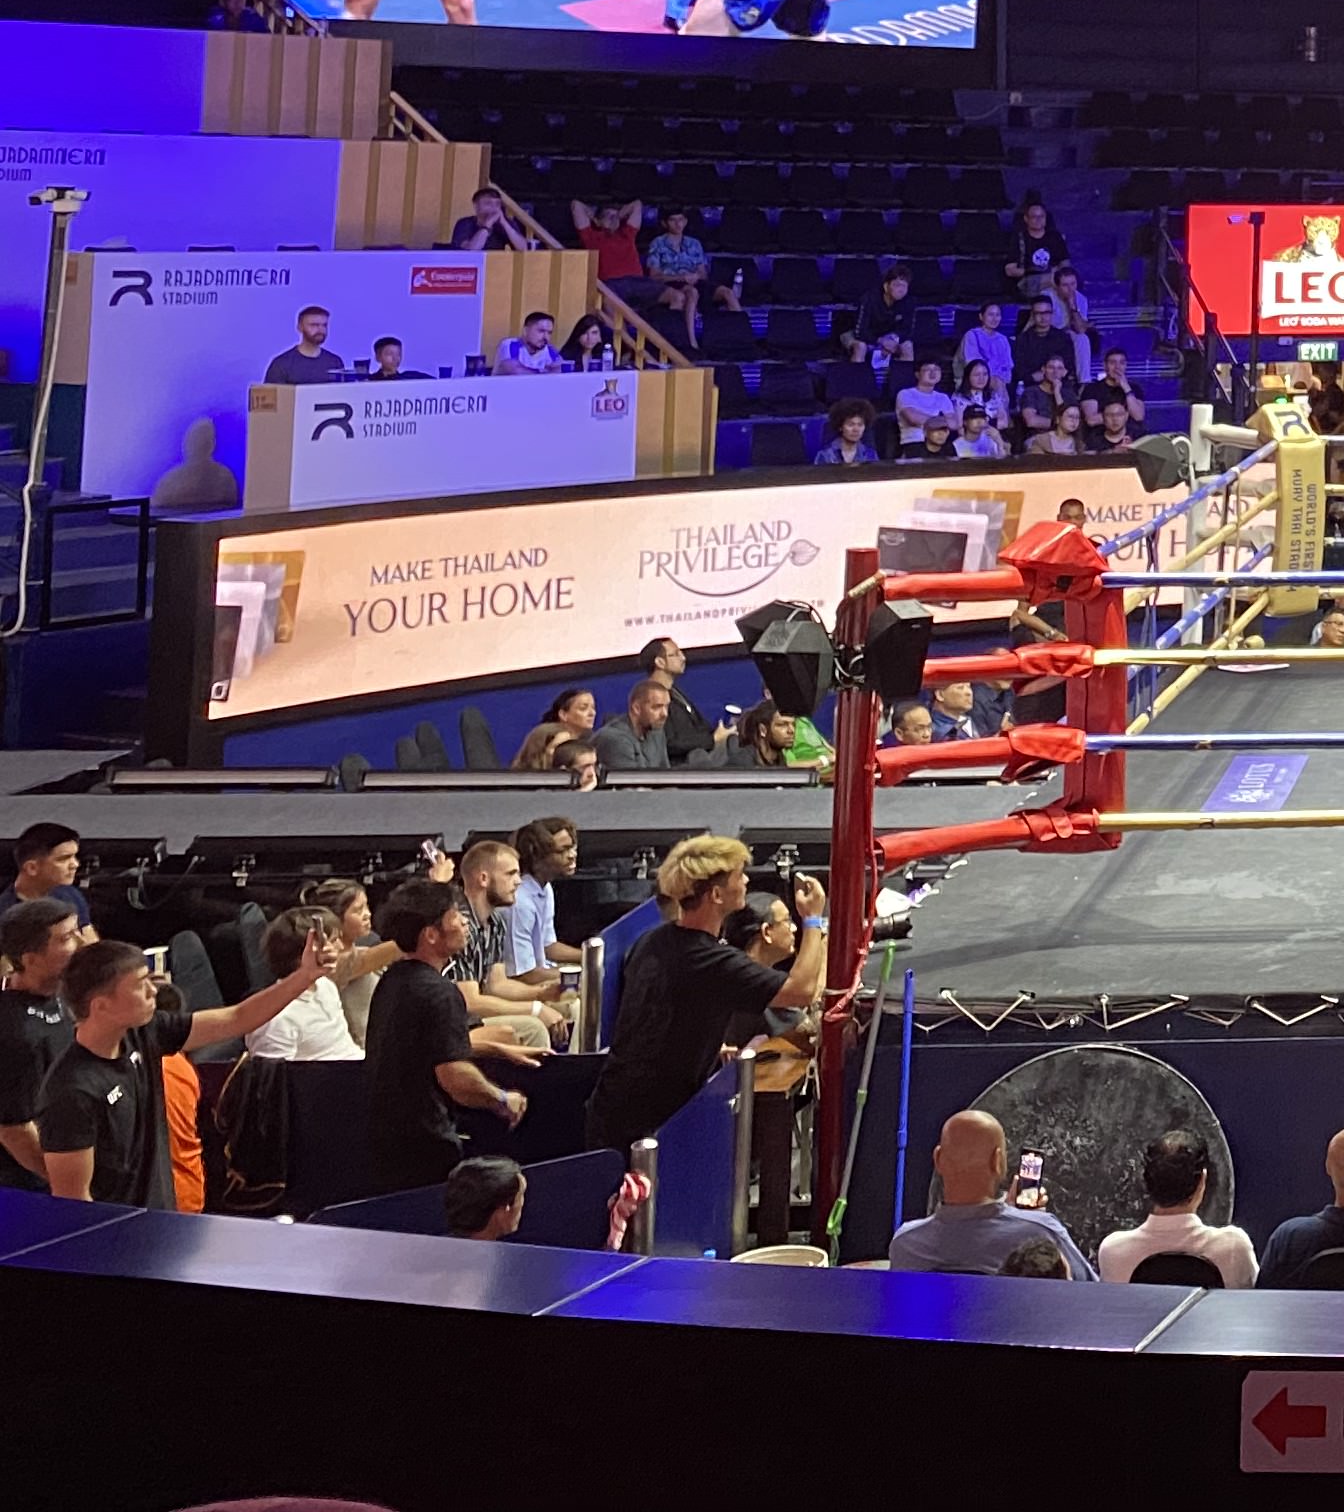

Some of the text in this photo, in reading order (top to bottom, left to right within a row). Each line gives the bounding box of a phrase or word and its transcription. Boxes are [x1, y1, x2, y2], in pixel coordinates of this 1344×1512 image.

[163, 269, 291, 288] RAJADAMNERN
[163, 291, 218, 306] STADIUM
[1300, 342, 1336, 360] EXIT
[363, 395, 488, 418] RAJADAMNERN
[595, 398, 625, 413] LEO
[362, 421, 417, 438] STADIUM
[1085, 504, 1143, 523] MAKE
[670, 519, 793, 550] THAILAND
[1285, 469, 1302, 593] MUAY THAI STAD
[369, 547, 549, 587] MAKE THAILAND
[638, 541, 781, 580] PRIVILEGE
[343, 576, 576, 638] YOUR HOME
